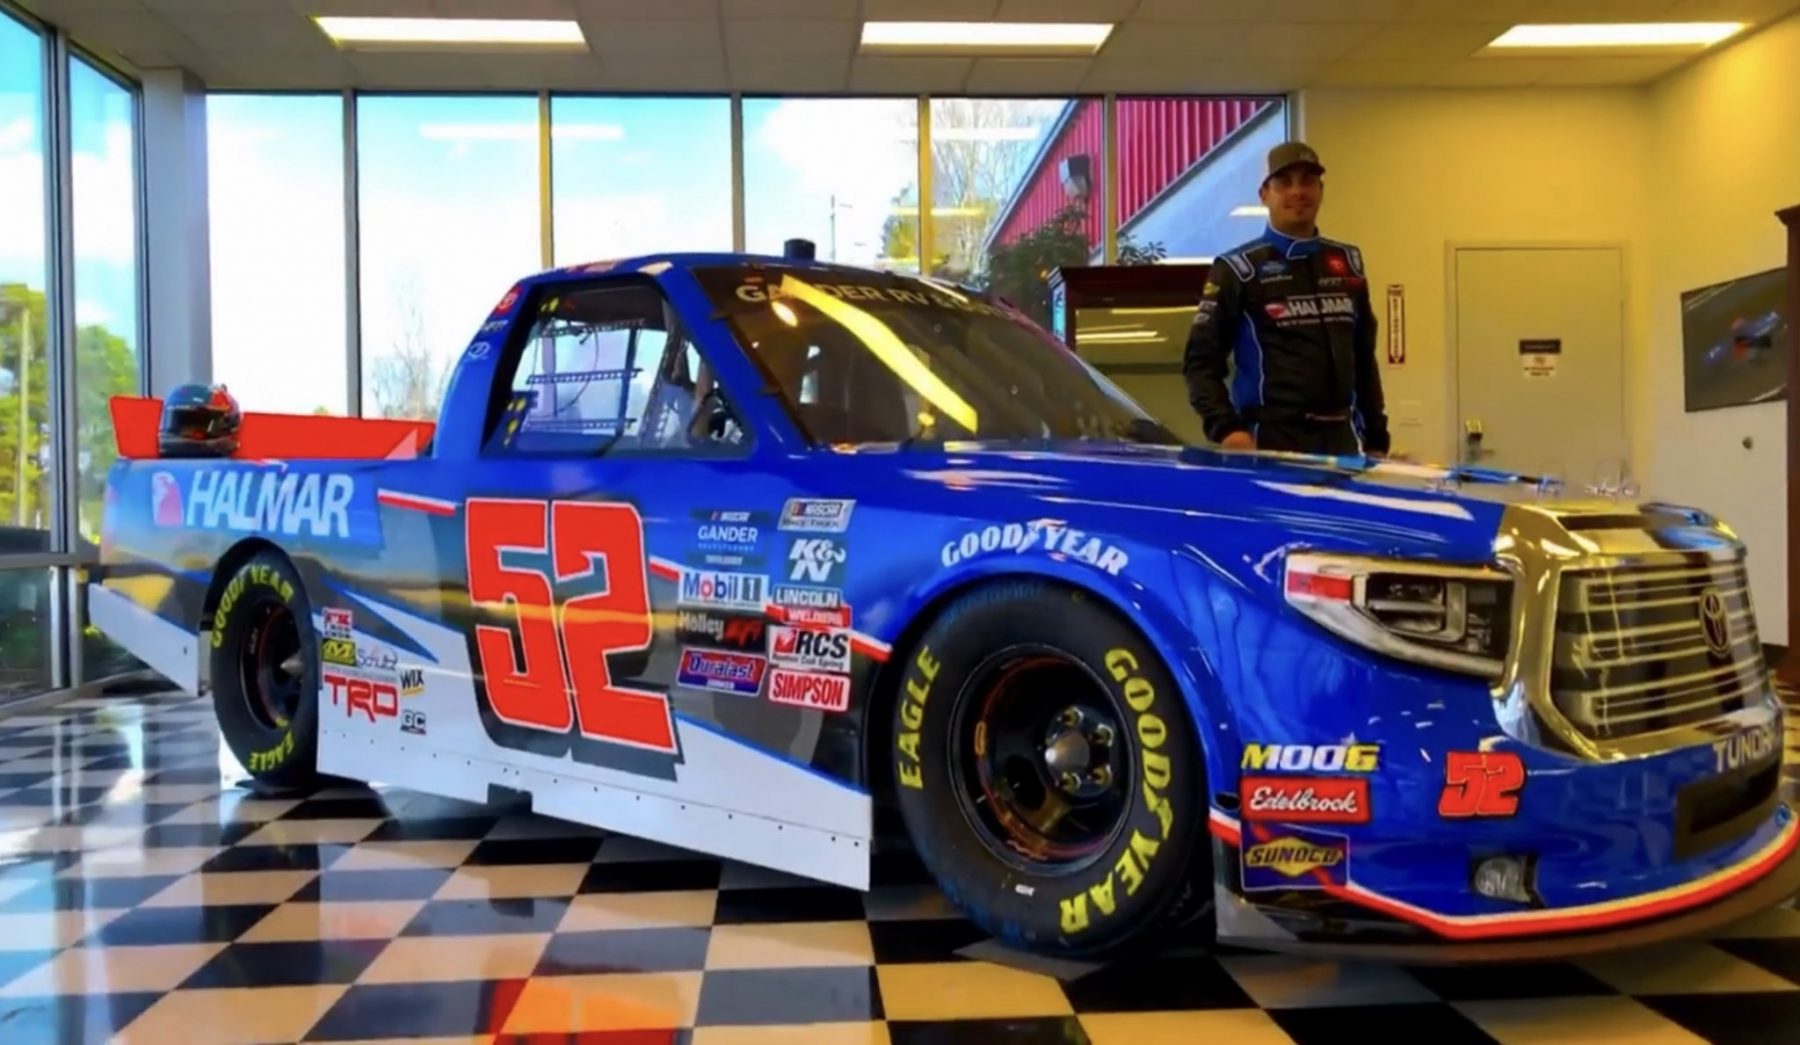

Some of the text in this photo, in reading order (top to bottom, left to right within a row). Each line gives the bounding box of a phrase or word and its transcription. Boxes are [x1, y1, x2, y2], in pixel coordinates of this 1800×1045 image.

[736, 284, 888, 302] GADER
[186, 469, 355, 538] HALMAR
[697, 525, 758, 544] GANDER
[684, 573, 740, 600] Mobil
[775, 587, 839, 608] LINCOLN
[464, 496, 680, 755] 52
[679, 610, 724, 643] Holley
[795, 630, 849, 660] RCS
[400, 669, 424, 690] WIX
[689, 653, 757, 681] Duralast
[324, 674, 398, 723] TRD
[772, 672, 844, 707] SIMPSON
[896, 645, 942, 790] EAGLE
[249, 731, 296, 772] EAGLE
[1240, 744, 1380, 771] MOOG
[1437, 752, 1525, 816] 52
[1249, 785, 1359, 815] Edelbrock
[1247, 847, 1343, 866] SUNOCO
